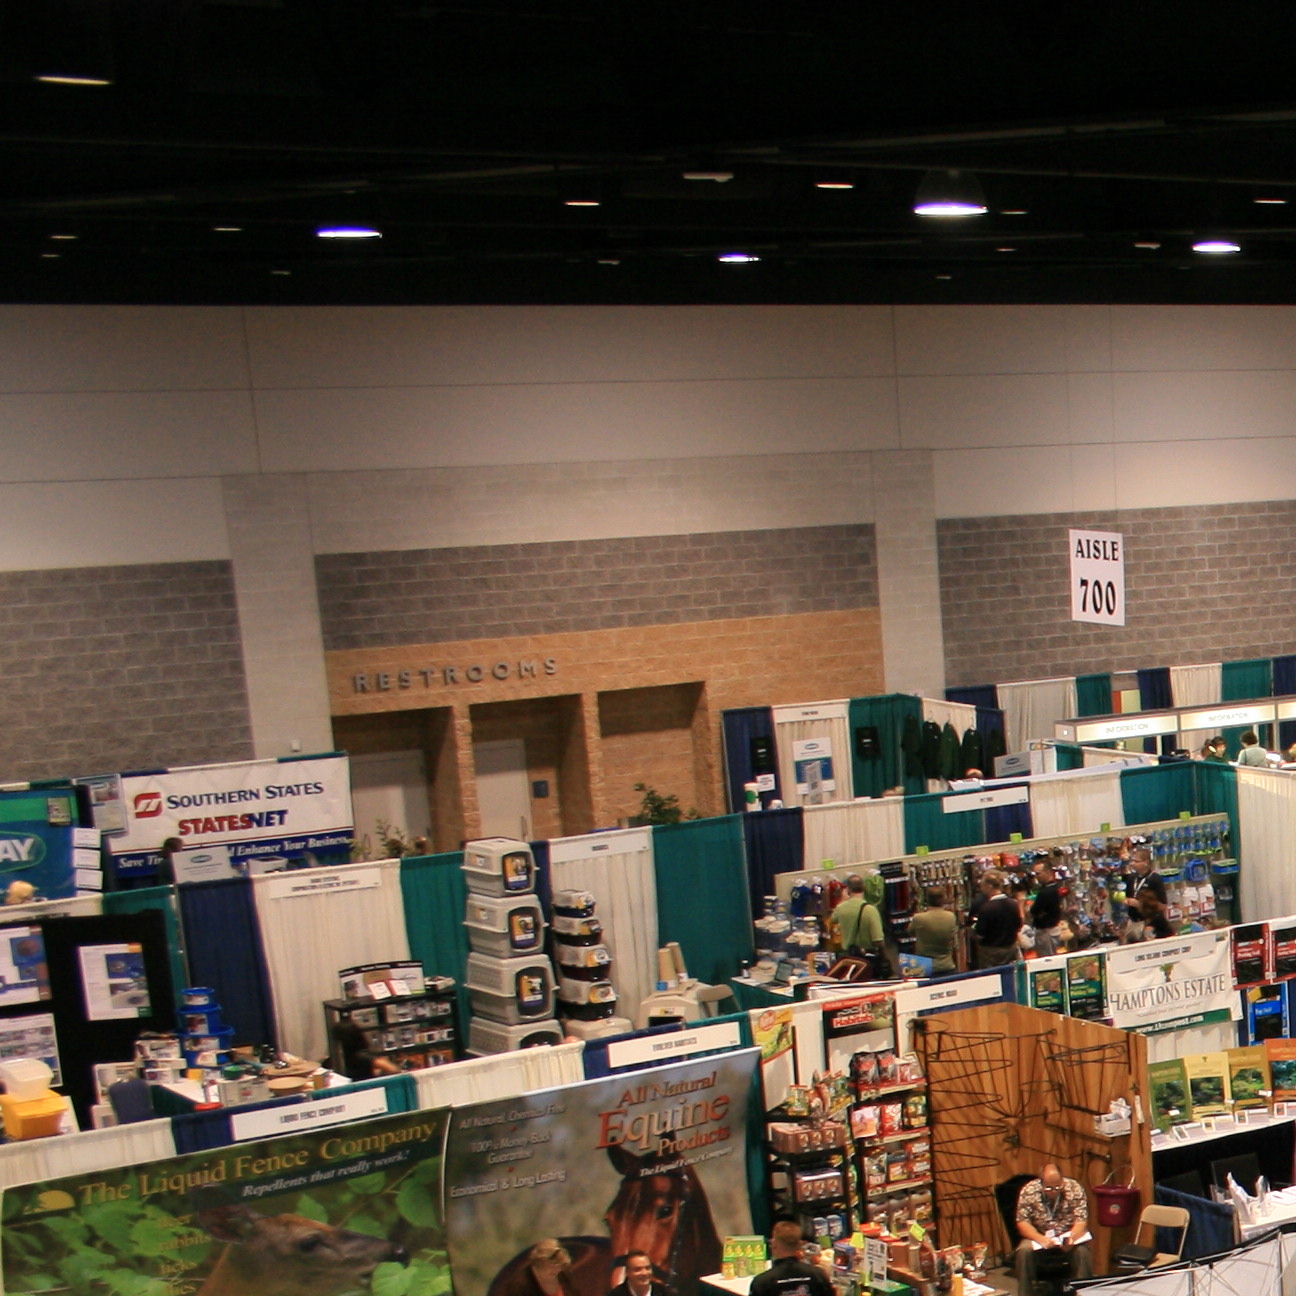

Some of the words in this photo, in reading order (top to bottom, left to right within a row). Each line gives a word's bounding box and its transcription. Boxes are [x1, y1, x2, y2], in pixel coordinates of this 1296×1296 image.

[1076, 538, 1119, 561] AISLE
[1080, 578, 1116, 615] 700
[354, 657, 558, 695] RESTROOMS
[167, 788, 260, 809] SOUTHERN
[266, 782, 324, 799] STATES
[178, 809, 288, 835] STATESNET
[119, 856, 145, 868] Save
[237, 842, 281, 857] Enhance
[283, 839, 306, 852] Your
[1110, 985, 1181, 1011] HAMPTONS
[1185, 974, 1226, 998] ESTATE
[617, 1085, 648, 1108] All
[652, 1071, 717, 1101] Natural
[596, 1095, 730, 1150] Equine
[656, 1125, 731, 1156] Products
[79, 1182, 131, 1205] The
[139, 1160, 226, 1196] Liquid
[235, 1149, 310, 1179] Fence
[320, 1122, 437, 1160] Company
[242, 1177, 307, 1198] Repellents
[310, 1171, 335, 1183] that
[338, 1160, 372, 1176] really
